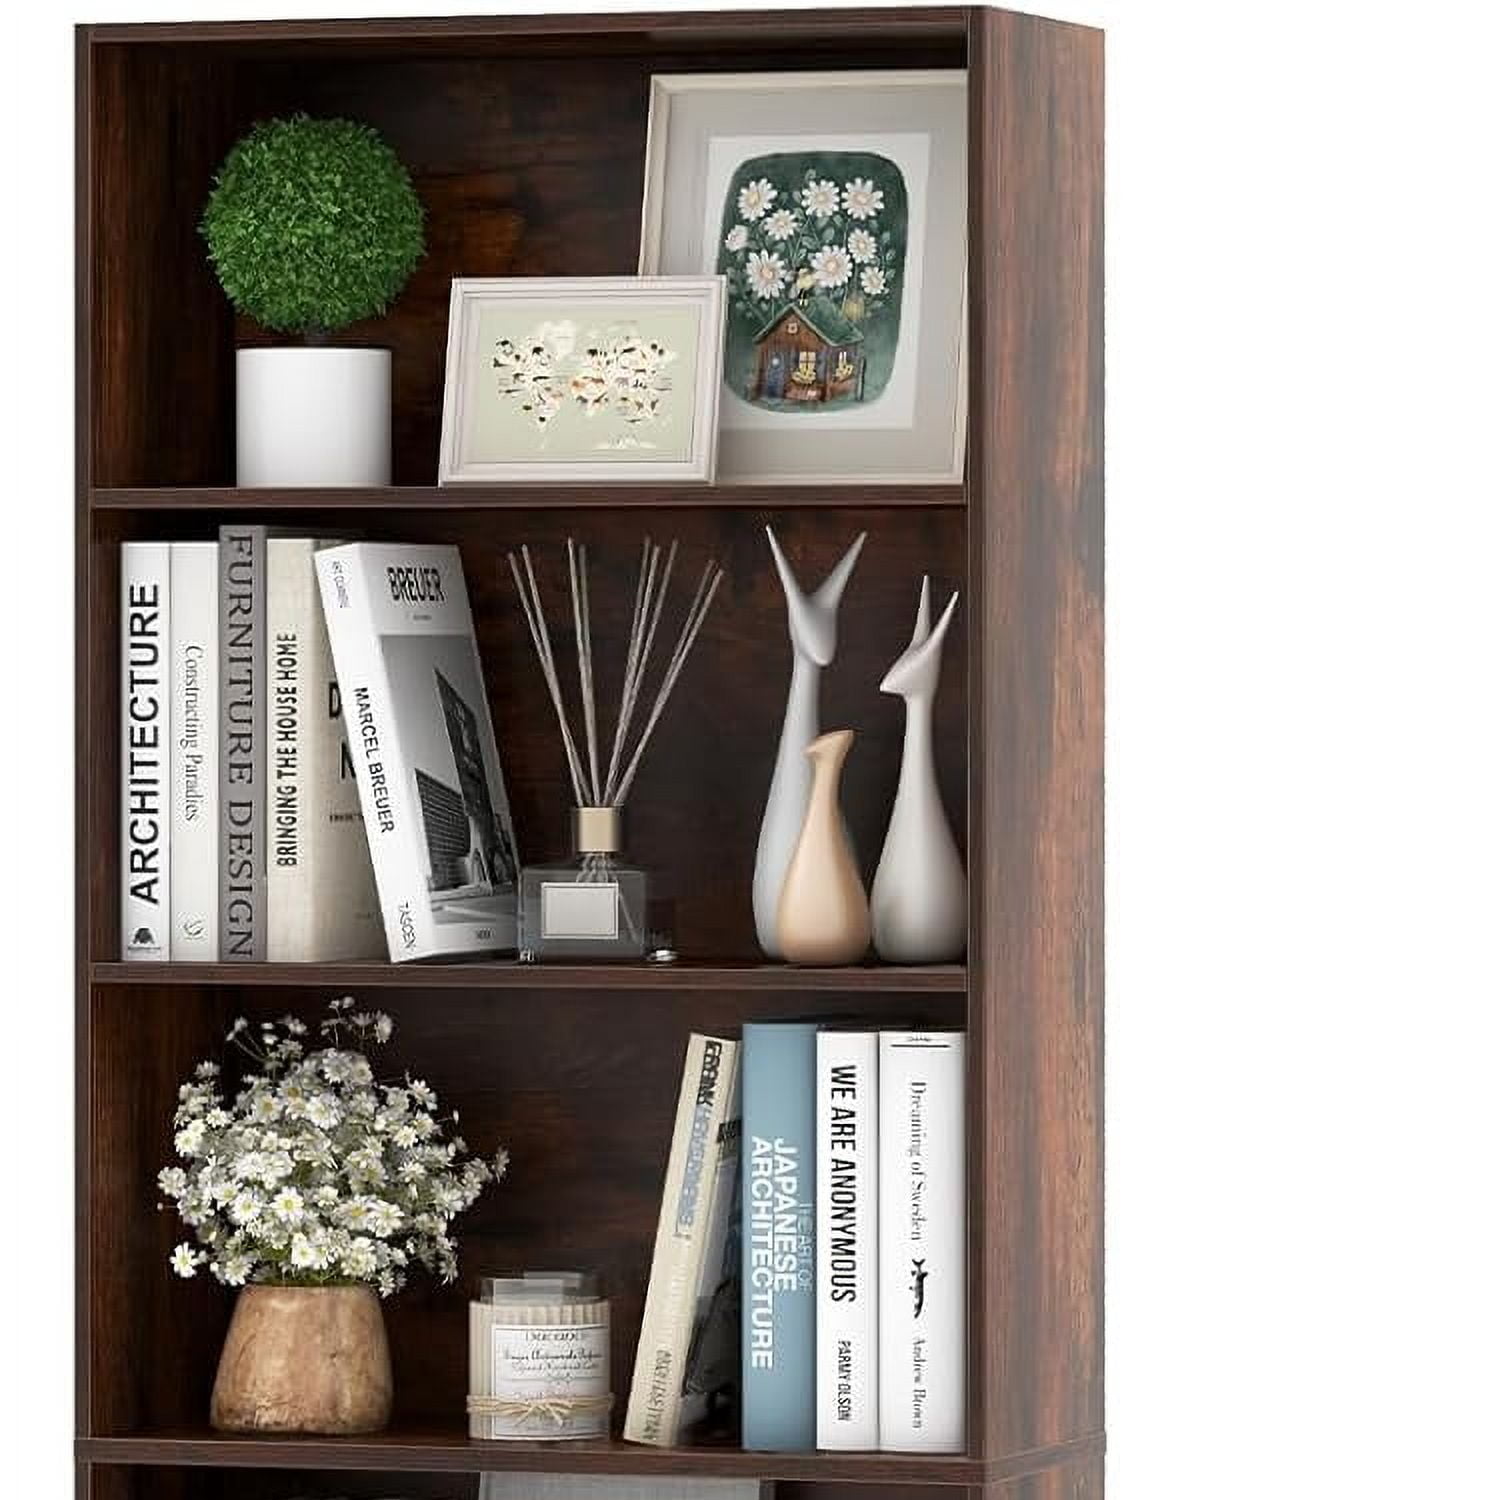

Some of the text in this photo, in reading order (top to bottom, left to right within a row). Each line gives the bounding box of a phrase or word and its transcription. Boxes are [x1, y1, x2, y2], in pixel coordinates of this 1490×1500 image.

[387, 567, 446, 602] BREUER
[129, 582, 159, 904] ARCHITECTURE
[180, 645, 204, 749] Constructing
[229, 535, 254, 957] FURNITURE DESIGN
[276, 633, 298, 865] BRINGING THE HOUSE HOME
[353, 687, 395, 833] MARCEL BREUER
[773, 1137, 797, 1291] JAPANESE
[830, 1064, 857, 1302] WE ARE ANONYMOUS
[910, 1081, 927, 1240] Dreaming of Sweden
[751, 1135, 774, 1369] ARCHITECTURE
[798, 1269, 814, 1290] OF
[836, 1340, 852, 1420] PARMY OLSON
[912, 1335, 926, 1383] Andrew
